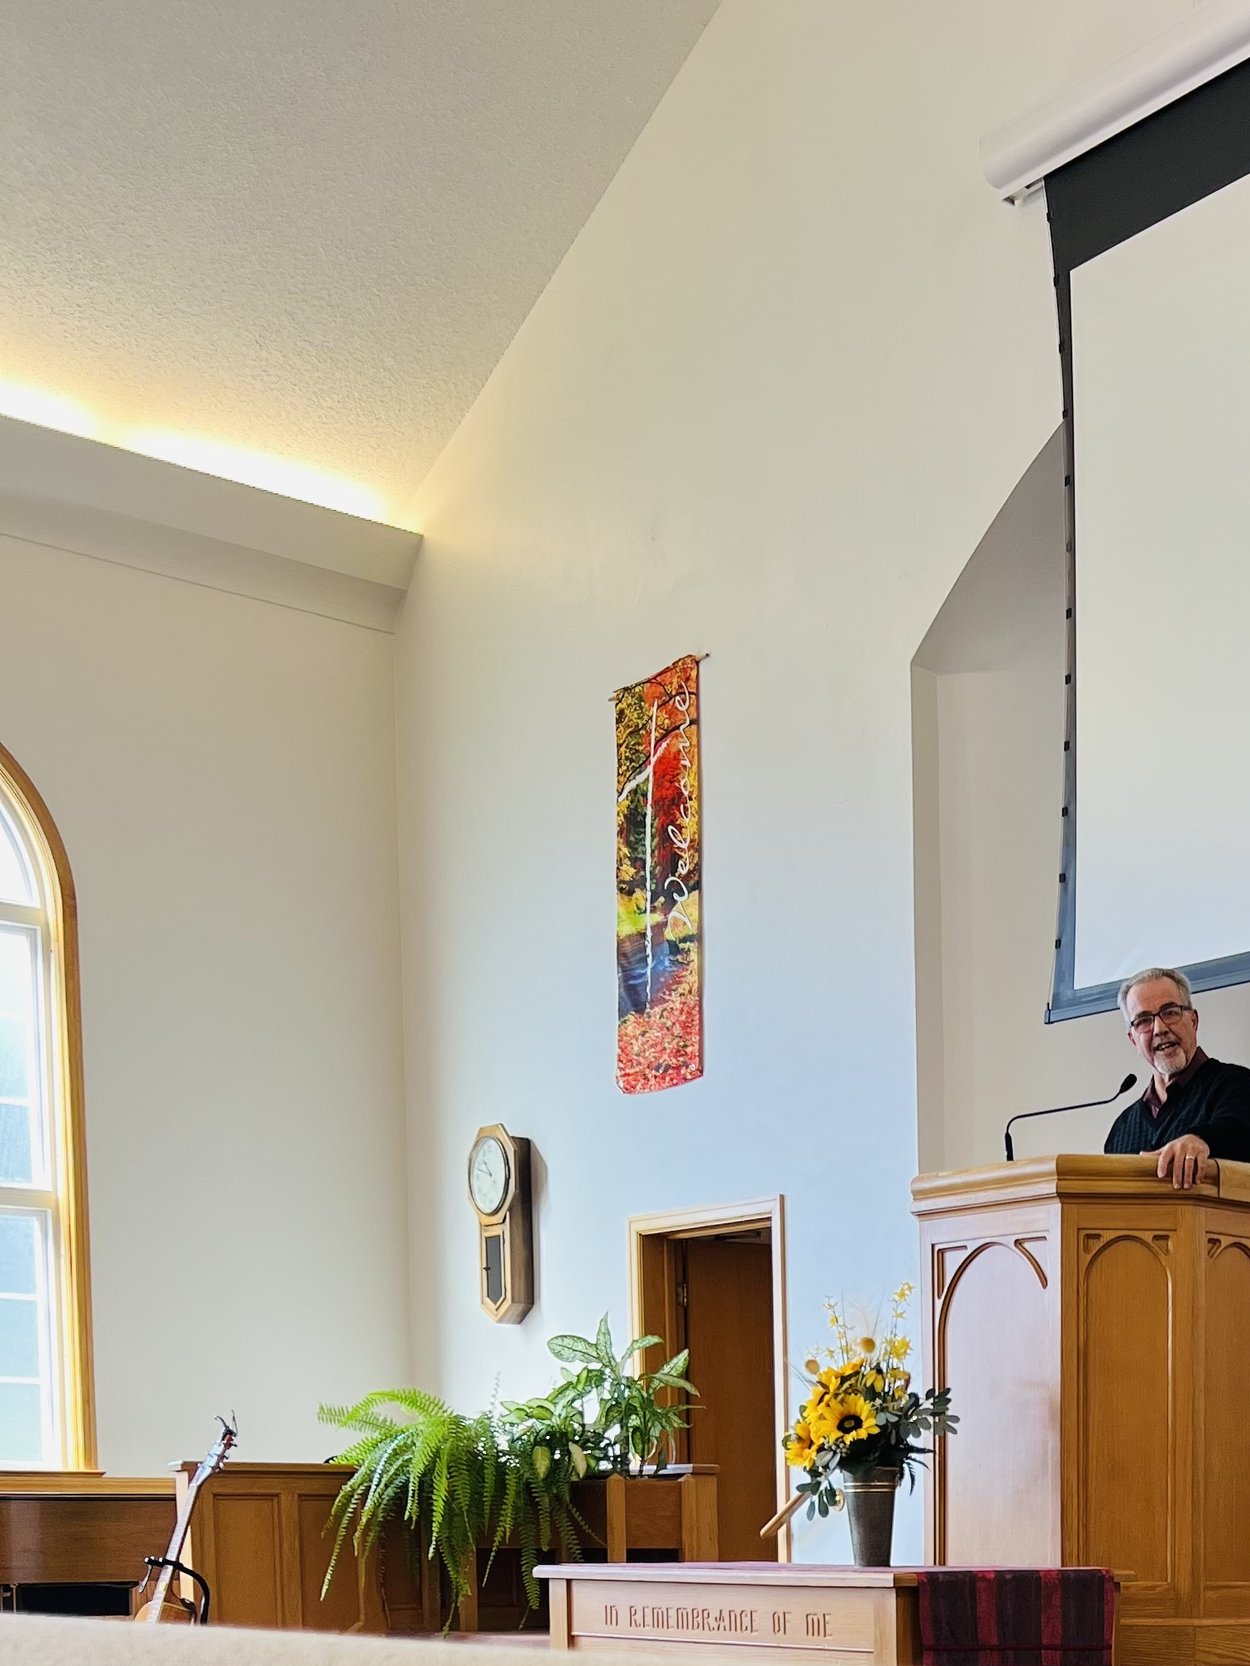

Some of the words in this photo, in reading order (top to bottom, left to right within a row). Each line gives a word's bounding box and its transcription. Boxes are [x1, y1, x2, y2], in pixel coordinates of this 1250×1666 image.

[664, 681, 692, 941] Welcome
[604, 1604, 619, 1627] IN
[629, 1605, 759, 1634] REMEMBRANCE
[772, 1611, 792, 1636] OF
[805, 1612, 833, 1638] ME
